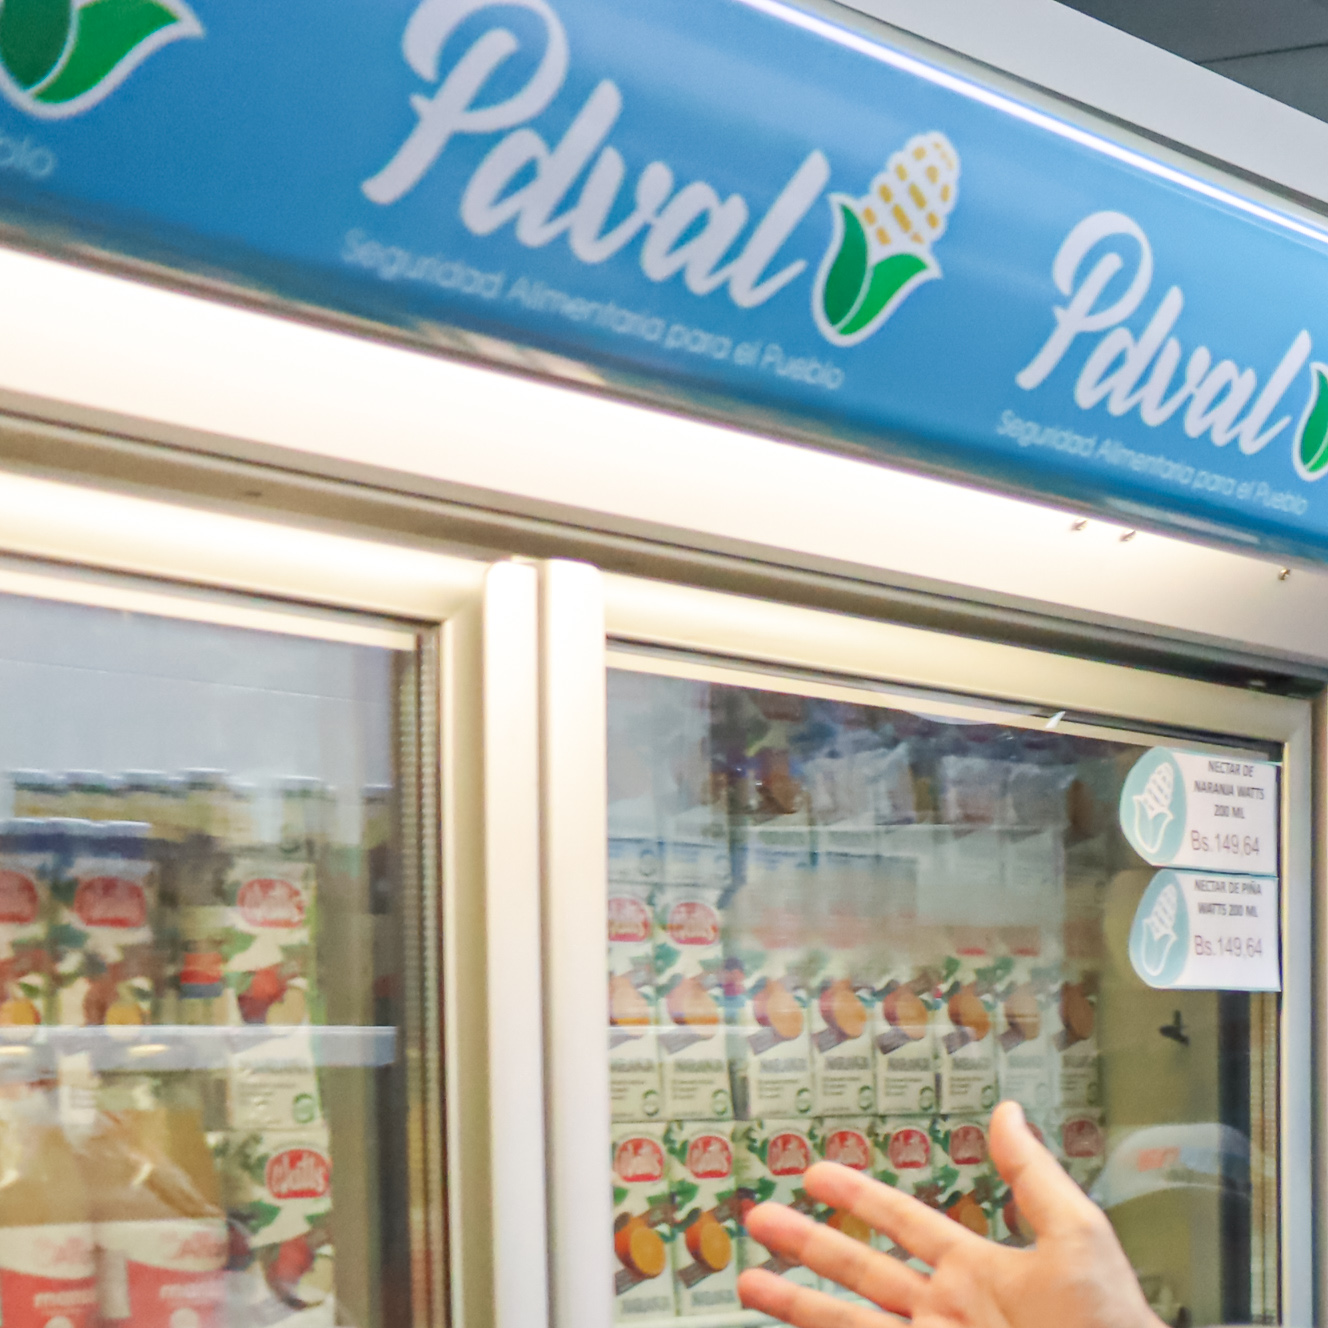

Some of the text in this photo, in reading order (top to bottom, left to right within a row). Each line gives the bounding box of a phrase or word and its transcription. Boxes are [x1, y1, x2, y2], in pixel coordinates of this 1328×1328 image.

[361, 0, 830, 308] Pdval
[342, 228, 501, 299] Seguridad
[506, 275, 665, 341] Alimentaria
[664, 324, 733, 362] para
[759, 343, 846, 392] Pueblo
[1015, 211, 1311, 455] Pdval
[1208, 760, 1255, 777] NECTAR DE
[1236, 786, 1265, 800] WATTS
[1194, 879, 1226, 894] NECTAR
[1228, 880, 1240, 894] DE
[1198, 903, 1227, 916] WATTS
